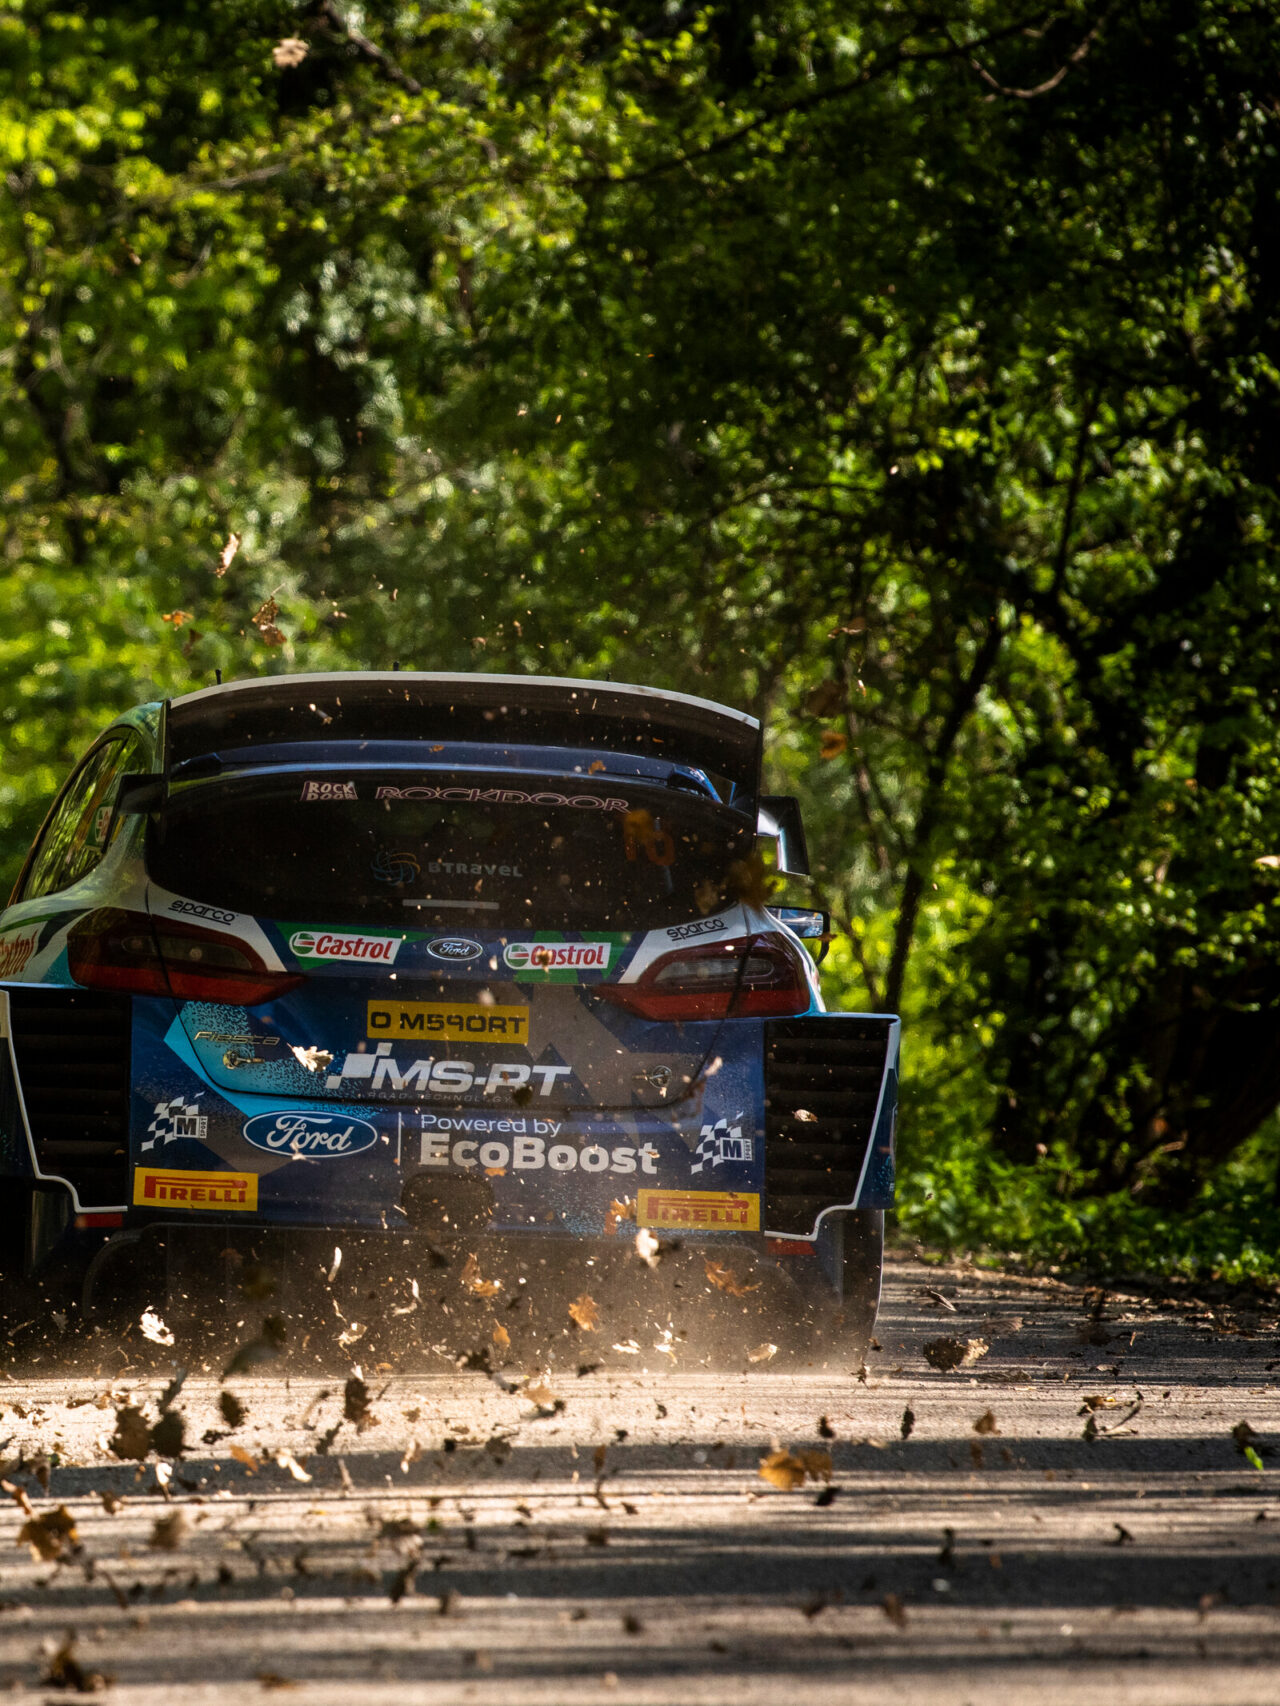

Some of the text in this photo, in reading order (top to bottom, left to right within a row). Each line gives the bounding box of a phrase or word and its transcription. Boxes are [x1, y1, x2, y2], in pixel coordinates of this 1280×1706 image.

[308, 781, 353, 794] ROCK
[375, 786, 632, 814] ROCKDOOR
[168, 900, 235, 925] sparco
[666, 919, 727, 941] sparco
[315, 935, 393, 960] Castrol
[194, 1031, 280, 1046] Fiesta
[371, 1058, 572, 1097] MS-RT
[266, 1115, 354, 1151] Ford
[421, 1114, 562, 1138] Powered by
[421, 1132, 658, 1175] EcoBoost
[144, 1175, 248, 1203] PIRELLI
[647, 1197, 750, 1223] PIRELLI
